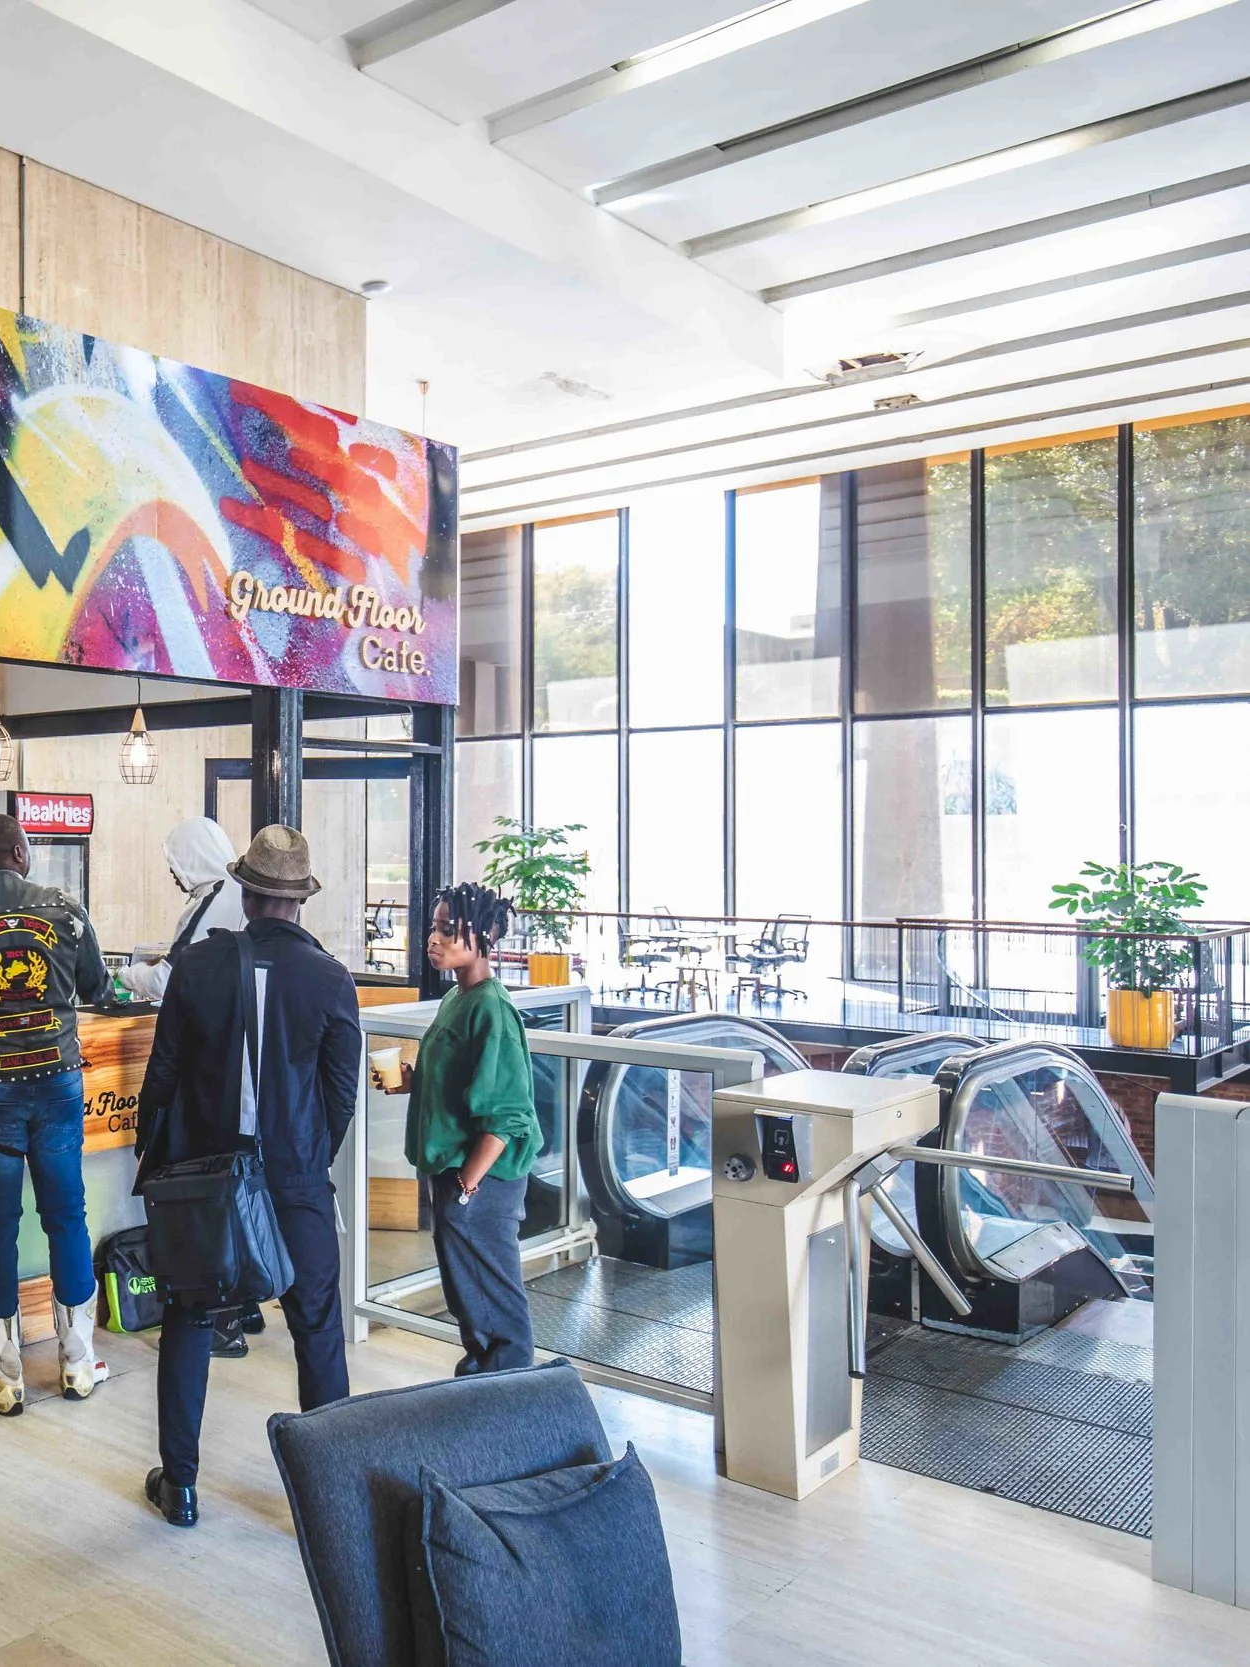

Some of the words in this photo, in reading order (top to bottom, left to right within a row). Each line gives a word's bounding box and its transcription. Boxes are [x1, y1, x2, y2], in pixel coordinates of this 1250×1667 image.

[229, 570, 348, 621] Ground
[345, 584, 426, 635] Floor
[18, 797, 91, 827] Healthies
[96, 1091, 139, 1116] Floo
[108, 1111, 139, 1132] Caf
